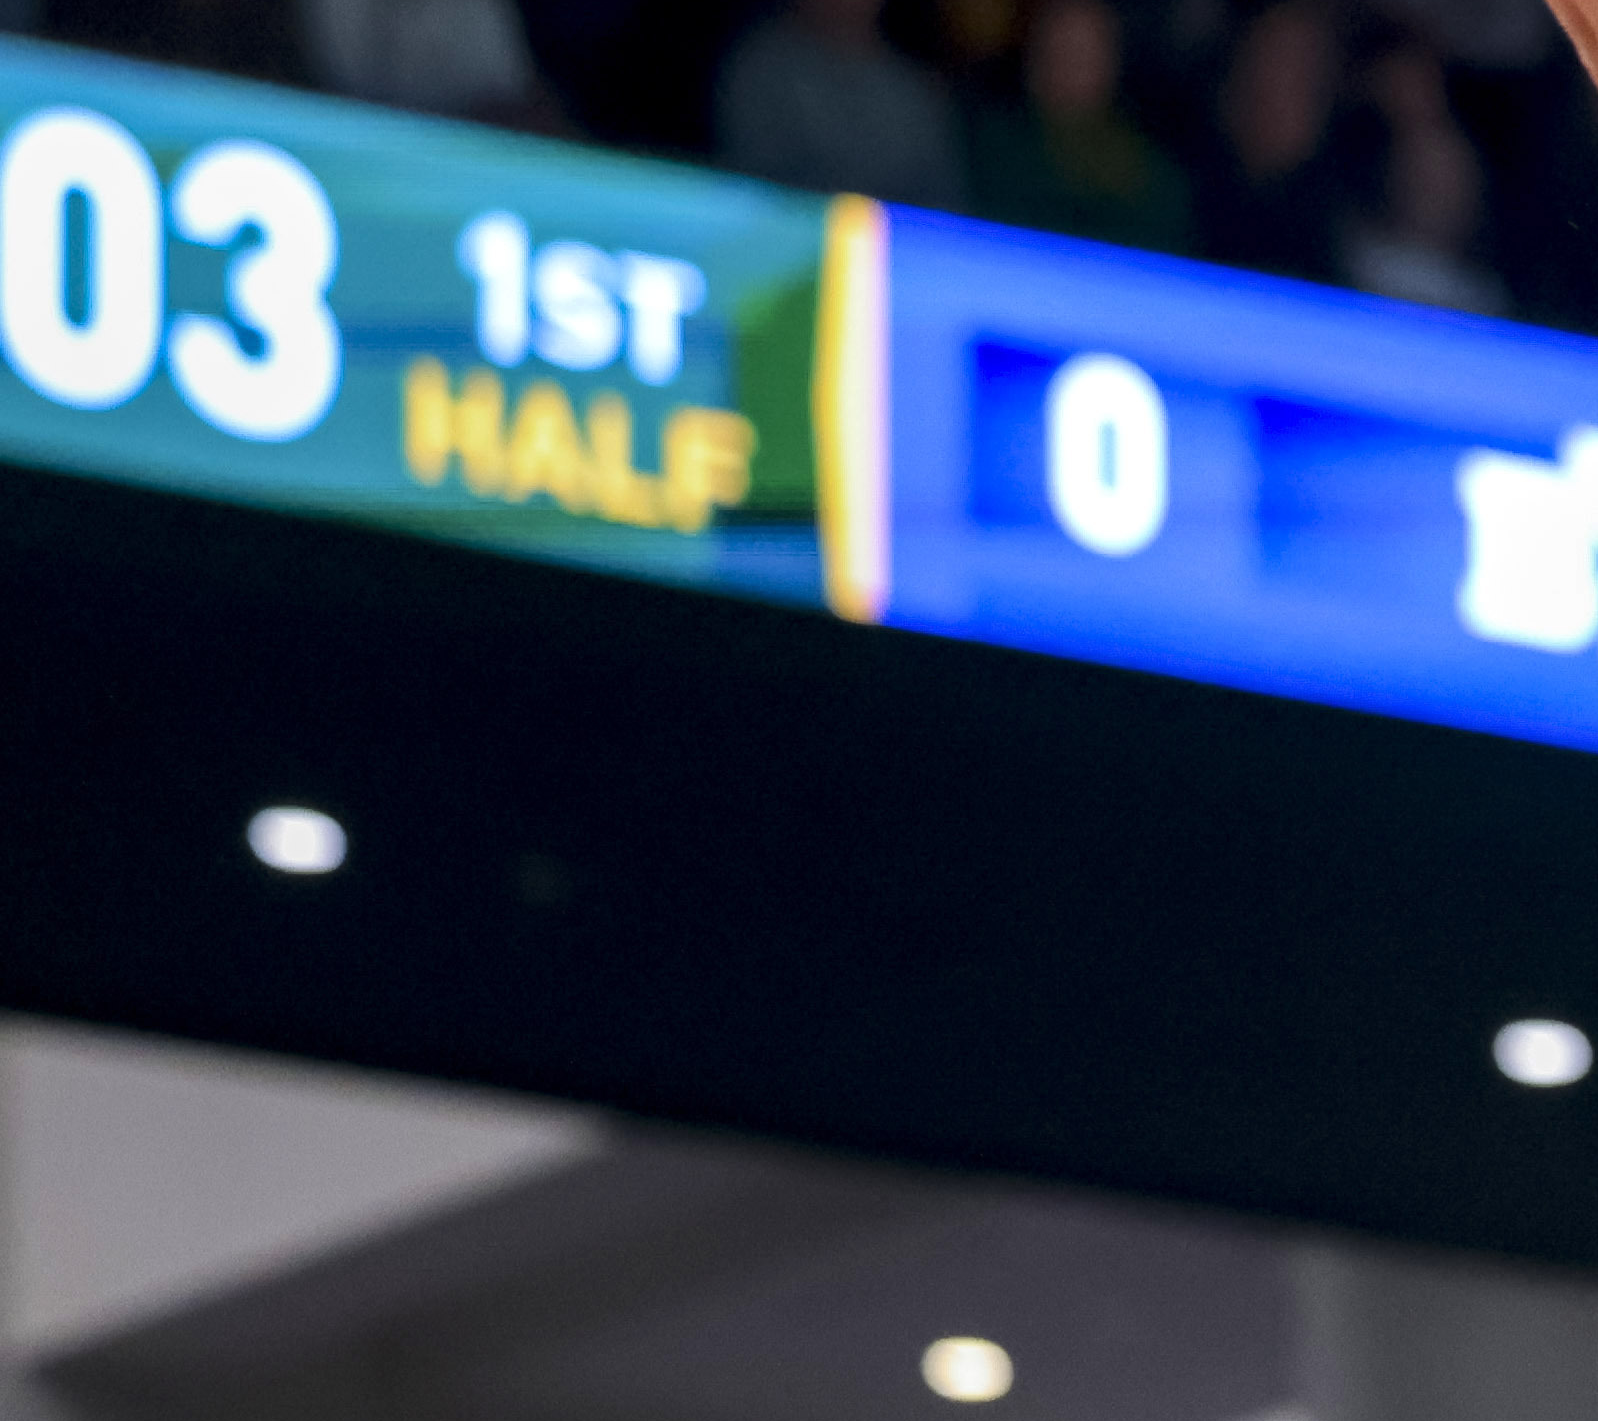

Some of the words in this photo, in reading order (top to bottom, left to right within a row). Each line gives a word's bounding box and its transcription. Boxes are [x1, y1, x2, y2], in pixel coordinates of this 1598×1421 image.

[456, 210, 709, 388] 1ST
[404, 352, 760, 538] HALF
[1045, 350, 1170, 558] 0
